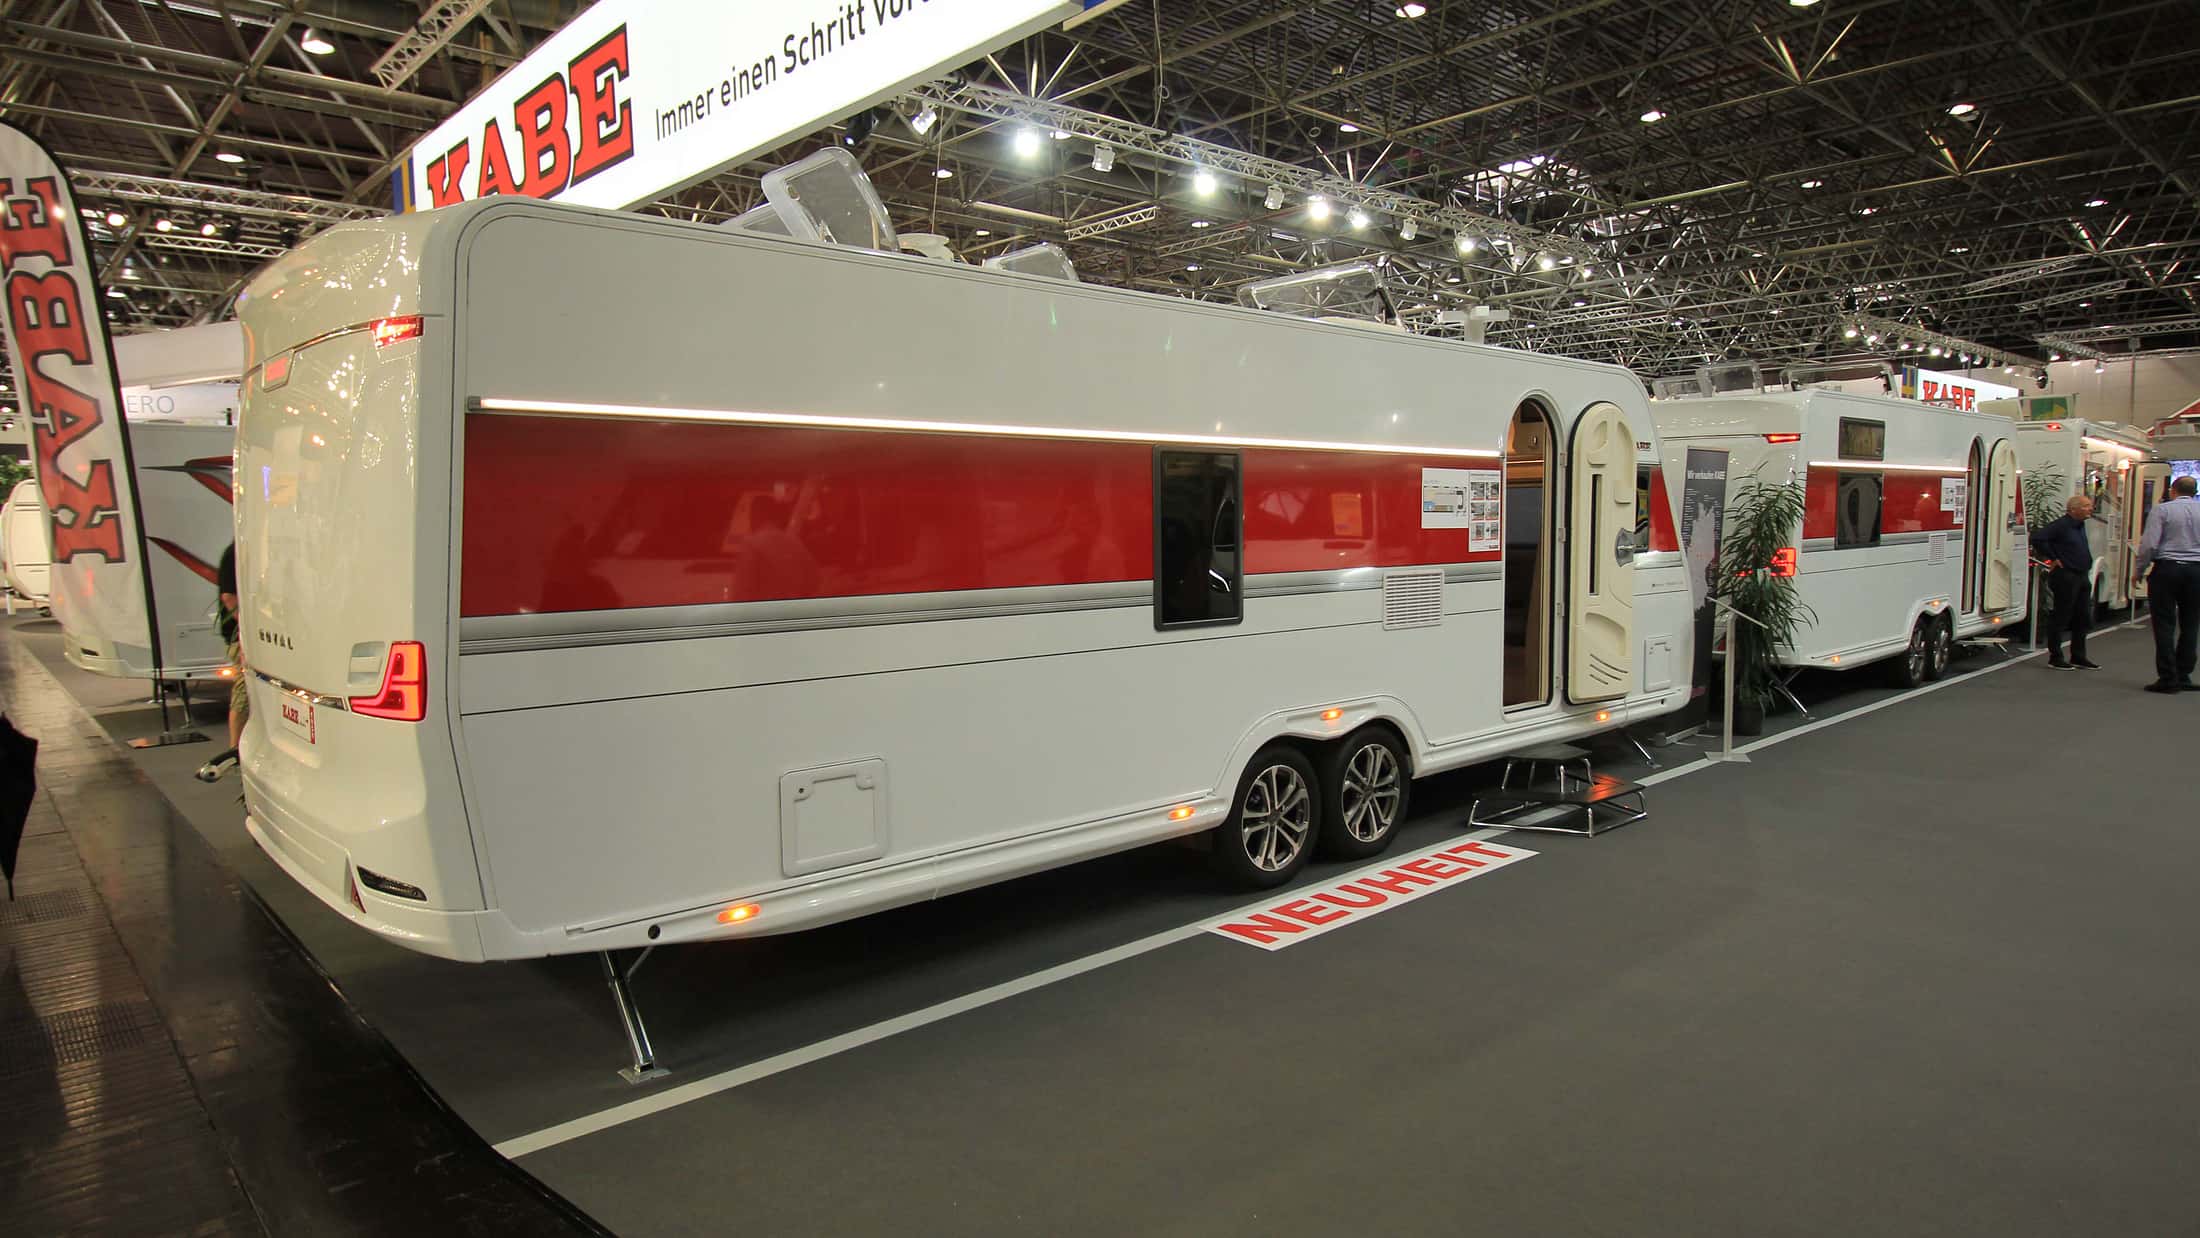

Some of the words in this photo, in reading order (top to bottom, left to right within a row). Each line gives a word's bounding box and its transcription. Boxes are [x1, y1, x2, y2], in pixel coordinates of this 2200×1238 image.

[427, 22, 634, 209] KABE
[656, 86, 715, 141] Immer
[720, 54, 776, 107] einen
[783, 0, 866, 74] Schritt
[1923, 380, 1976, 412] KABE
[1216, 841, 1513, 945] NEUHEIT
